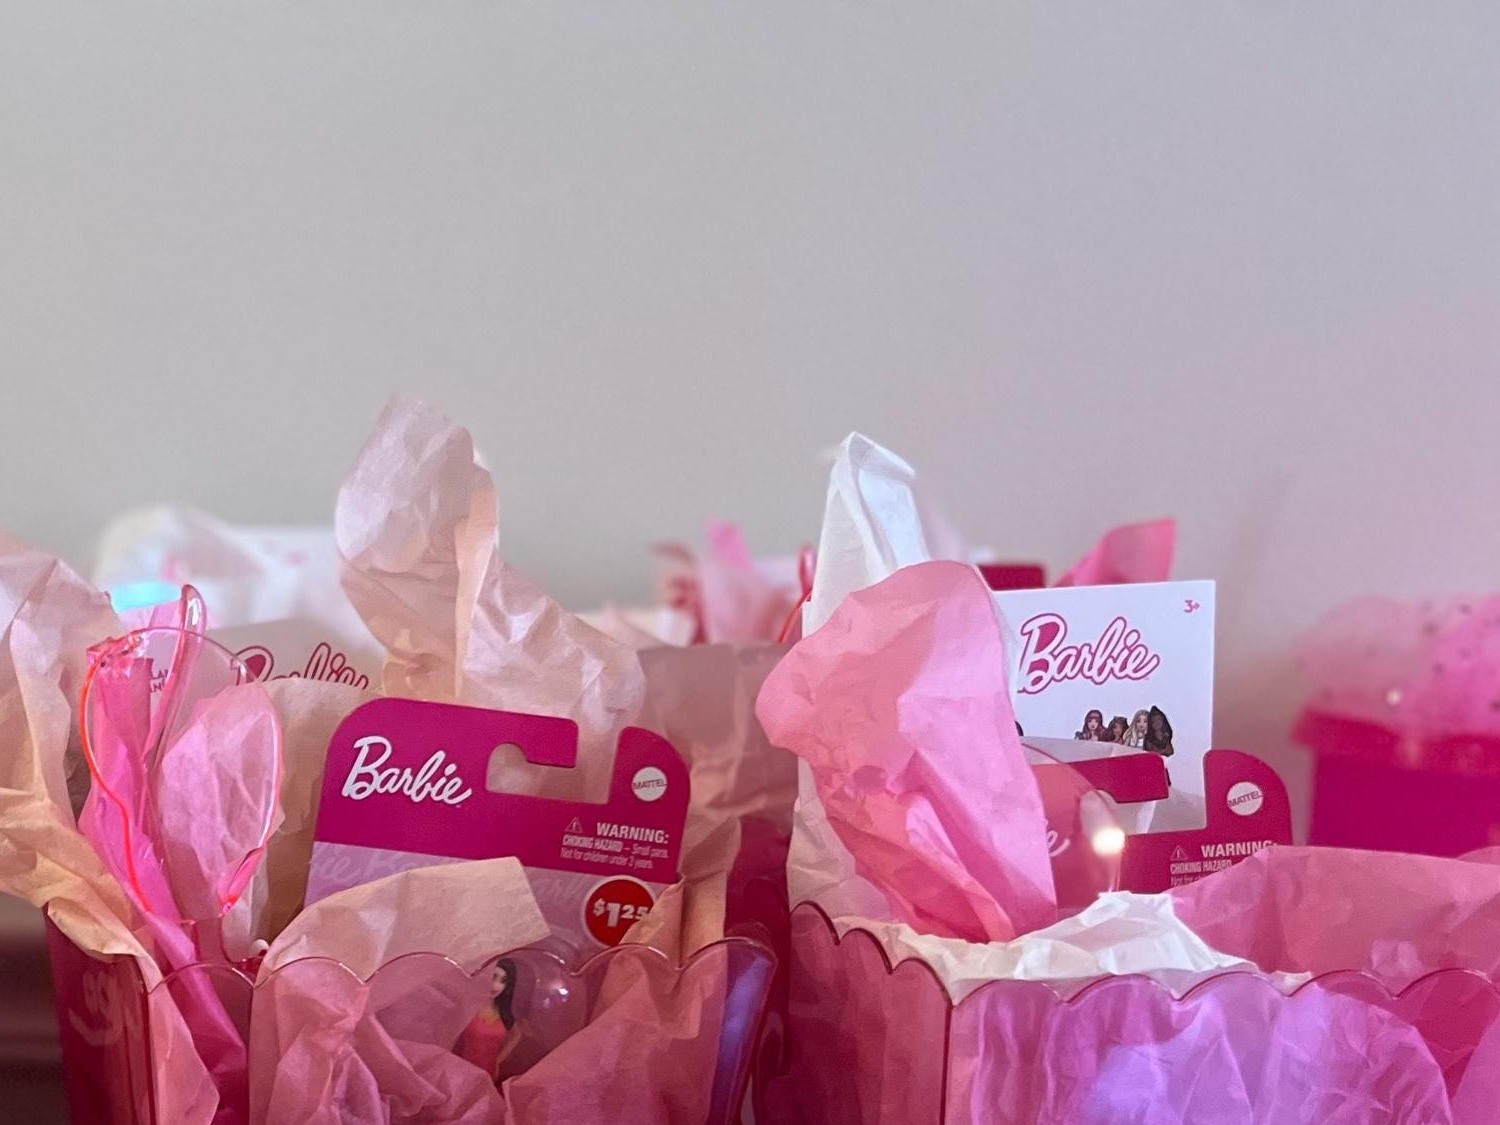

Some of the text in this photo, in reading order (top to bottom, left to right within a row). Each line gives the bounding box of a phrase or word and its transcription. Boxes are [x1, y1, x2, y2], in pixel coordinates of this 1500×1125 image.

[1017, 612, 1161, 695] Barbie
[341, 736, 473, 804] Barbie
[632, 779, 668, 790] MATTEL
[1228, 790, 1264, 808] MATTEL
[596, 822, 669, 844] WARNING:
[1170, 861, 1201, 874] CHOKING
